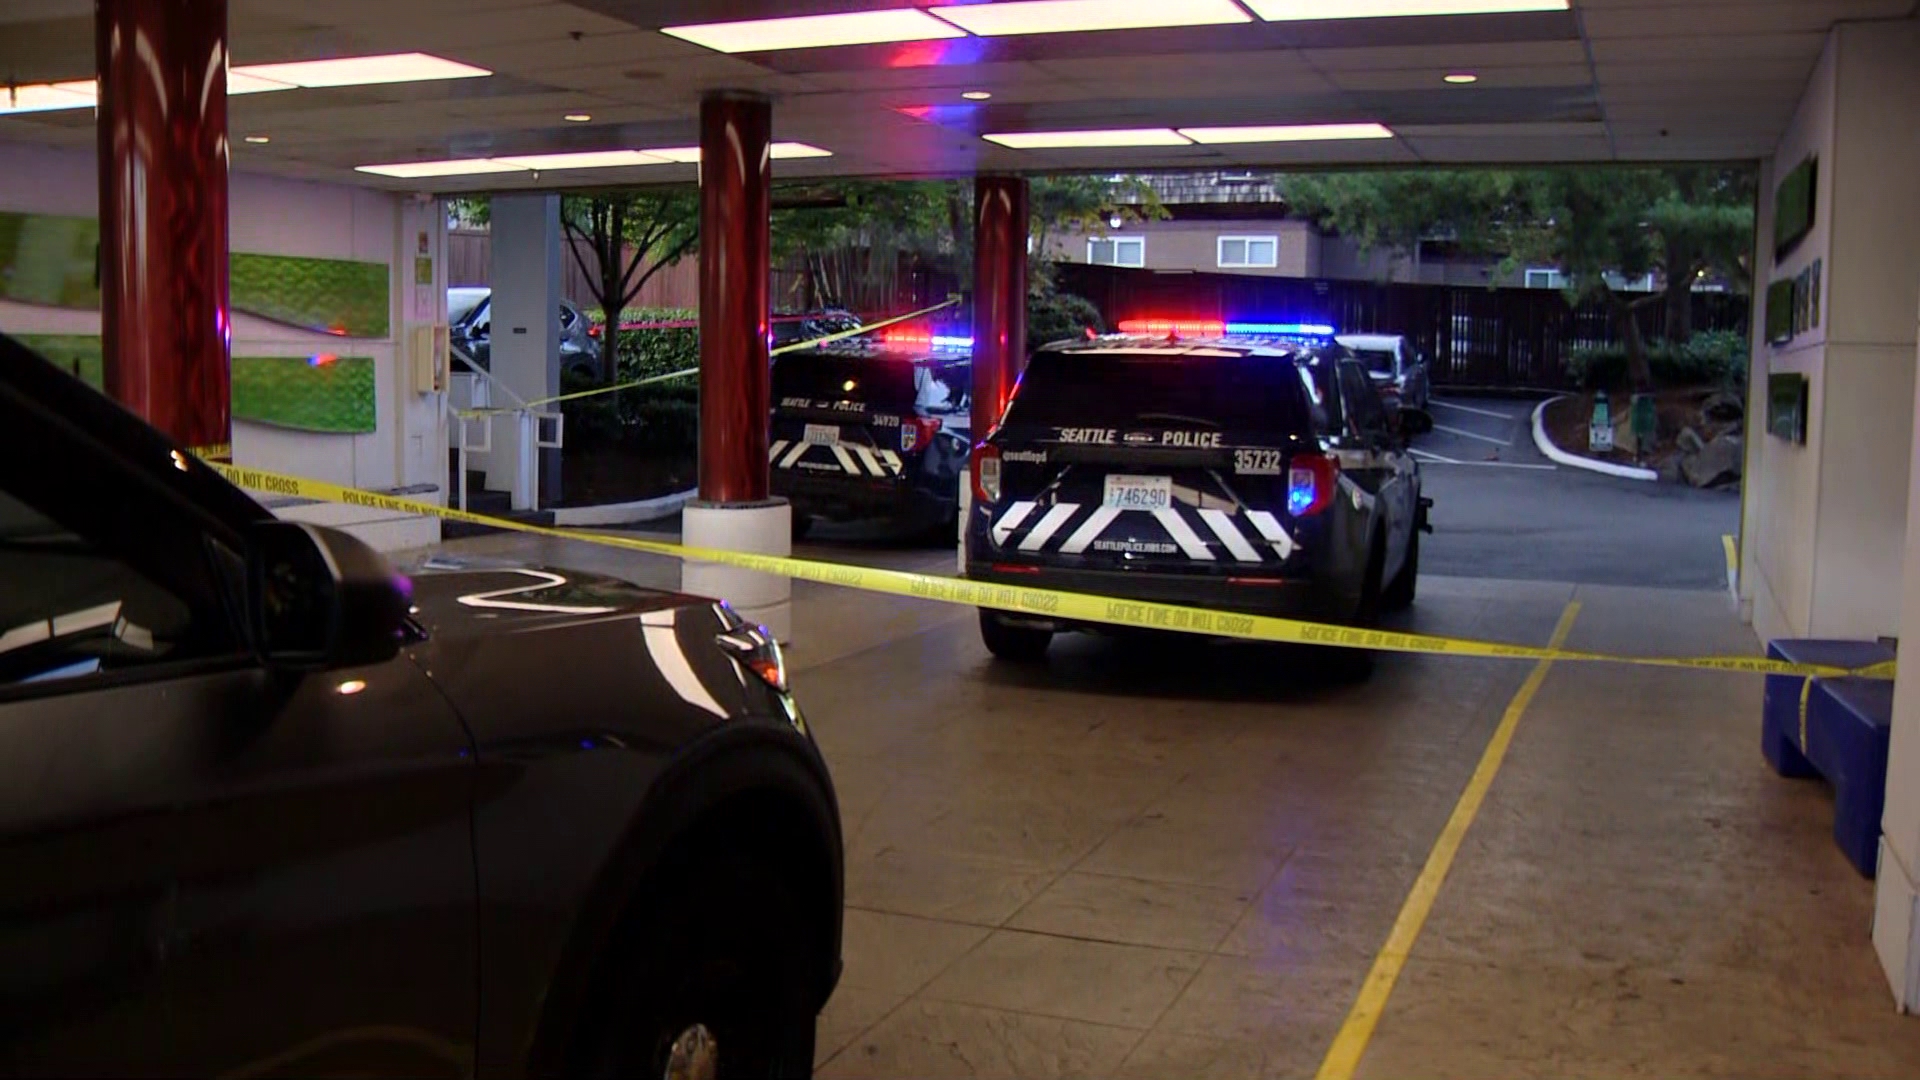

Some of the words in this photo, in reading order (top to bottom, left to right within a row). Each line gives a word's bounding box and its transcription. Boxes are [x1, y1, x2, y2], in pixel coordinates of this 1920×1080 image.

[833, 401, 865, 412] POLICE
[1059, 428, 1116, 443] SEATTLE
[1162, 430, 1222, 447] POLICE
[1234, 449, 1281, 472] 35732
[243, 471, 262, 489] NOT
[265, 475, 299, 495] CROSS
[342, 490, 375, 506] POLICE
[379, 497, 400, 511] LINE
